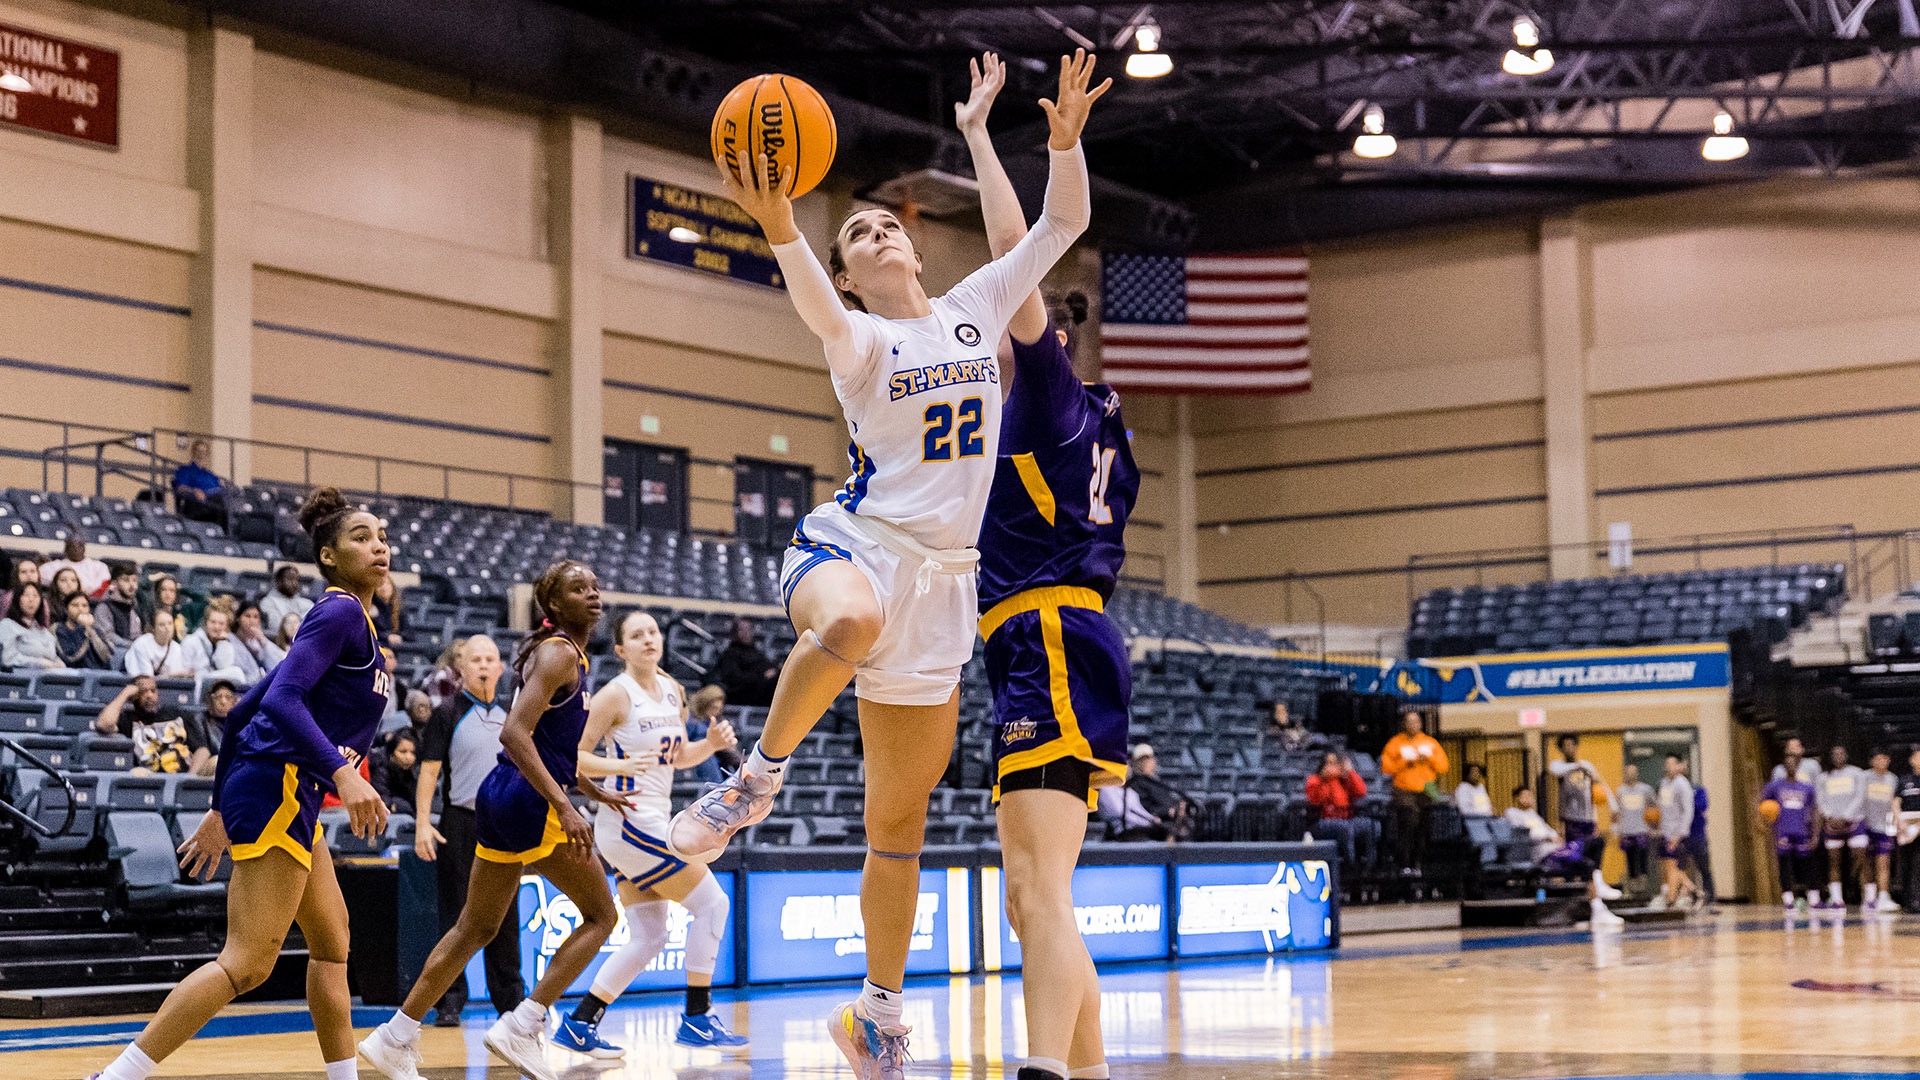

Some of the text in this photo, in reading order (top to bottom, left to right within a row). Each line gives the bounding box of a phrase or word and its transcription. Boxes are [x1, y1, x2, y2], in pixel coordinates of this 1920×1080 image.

[0, 31, 67, 71] TIONAL
[760, 101, 785, 184] Wilson
[921, 395, 986, 463] 22
[1088, 441, 1117, 525] 21
[1506, 661, 1697, 689] #RATTLERNATION
